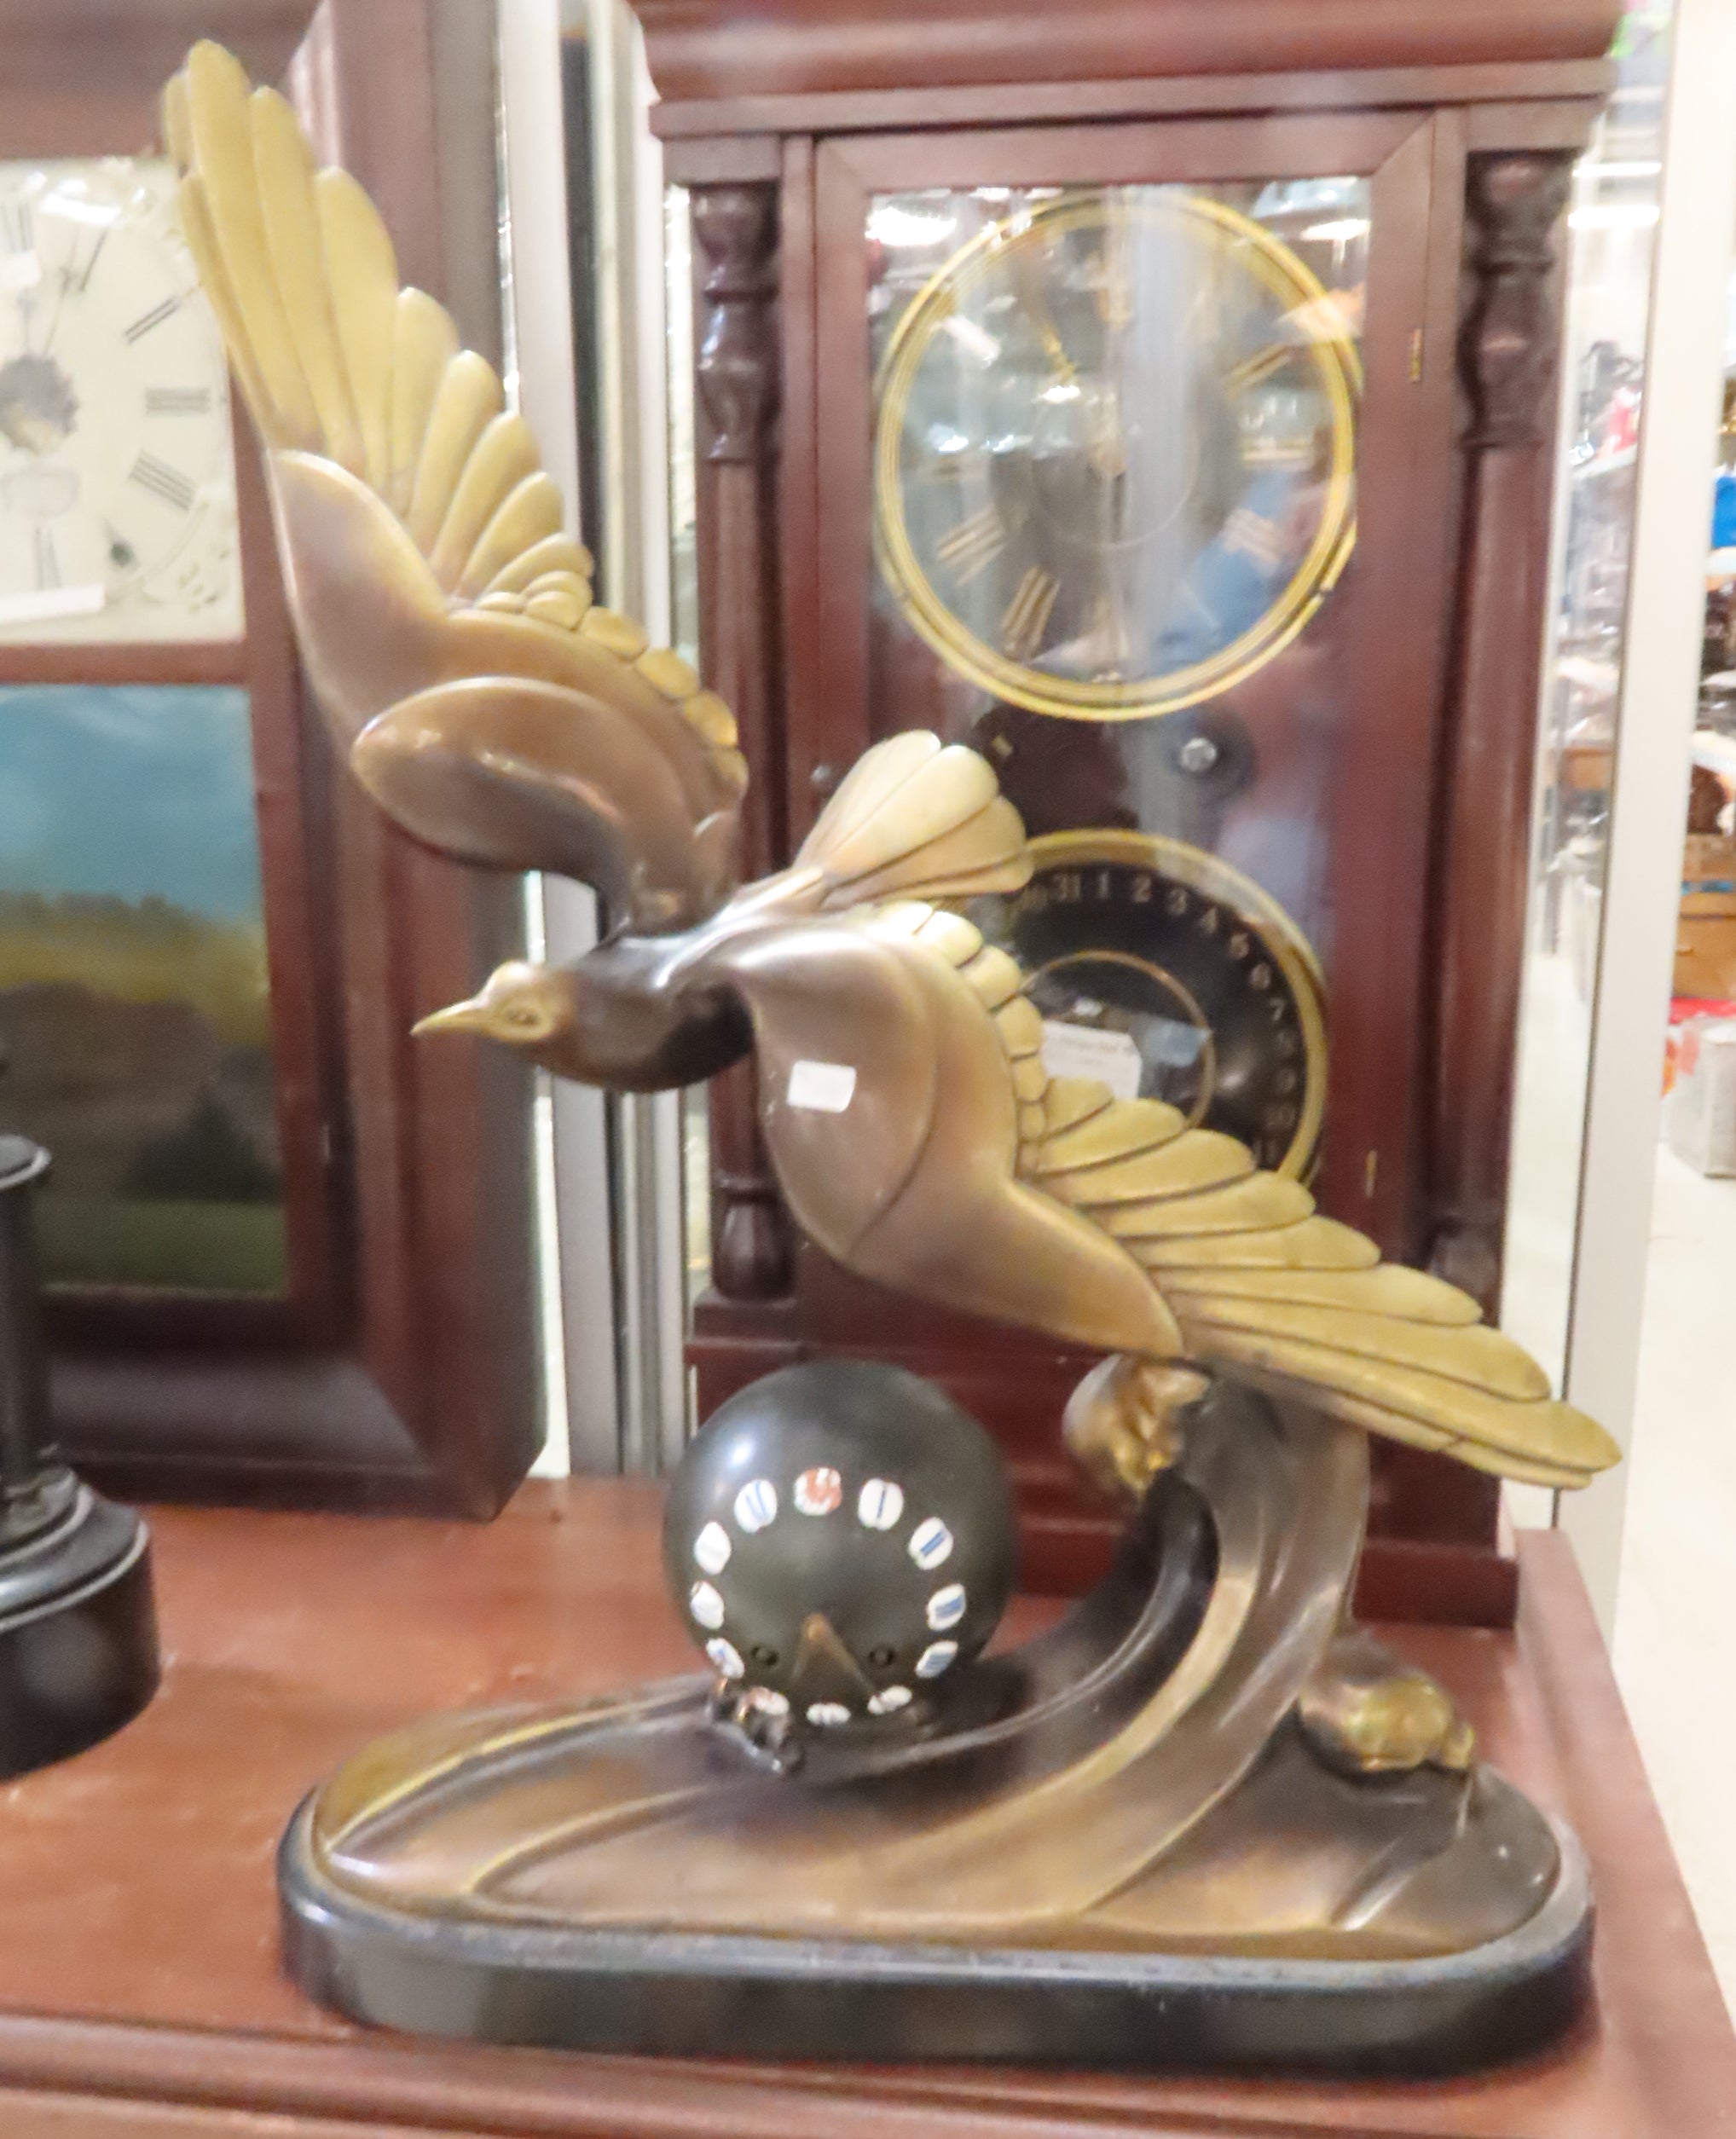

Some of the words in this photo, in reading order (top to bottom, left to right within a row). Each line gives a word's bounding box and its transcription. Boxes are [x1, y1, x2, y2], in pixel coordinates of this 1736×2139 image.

[1131, 875, 1153, 903] 2
[1167, 890, 1189, 916] 3
[1270, 998, 1288, 1023] 7
